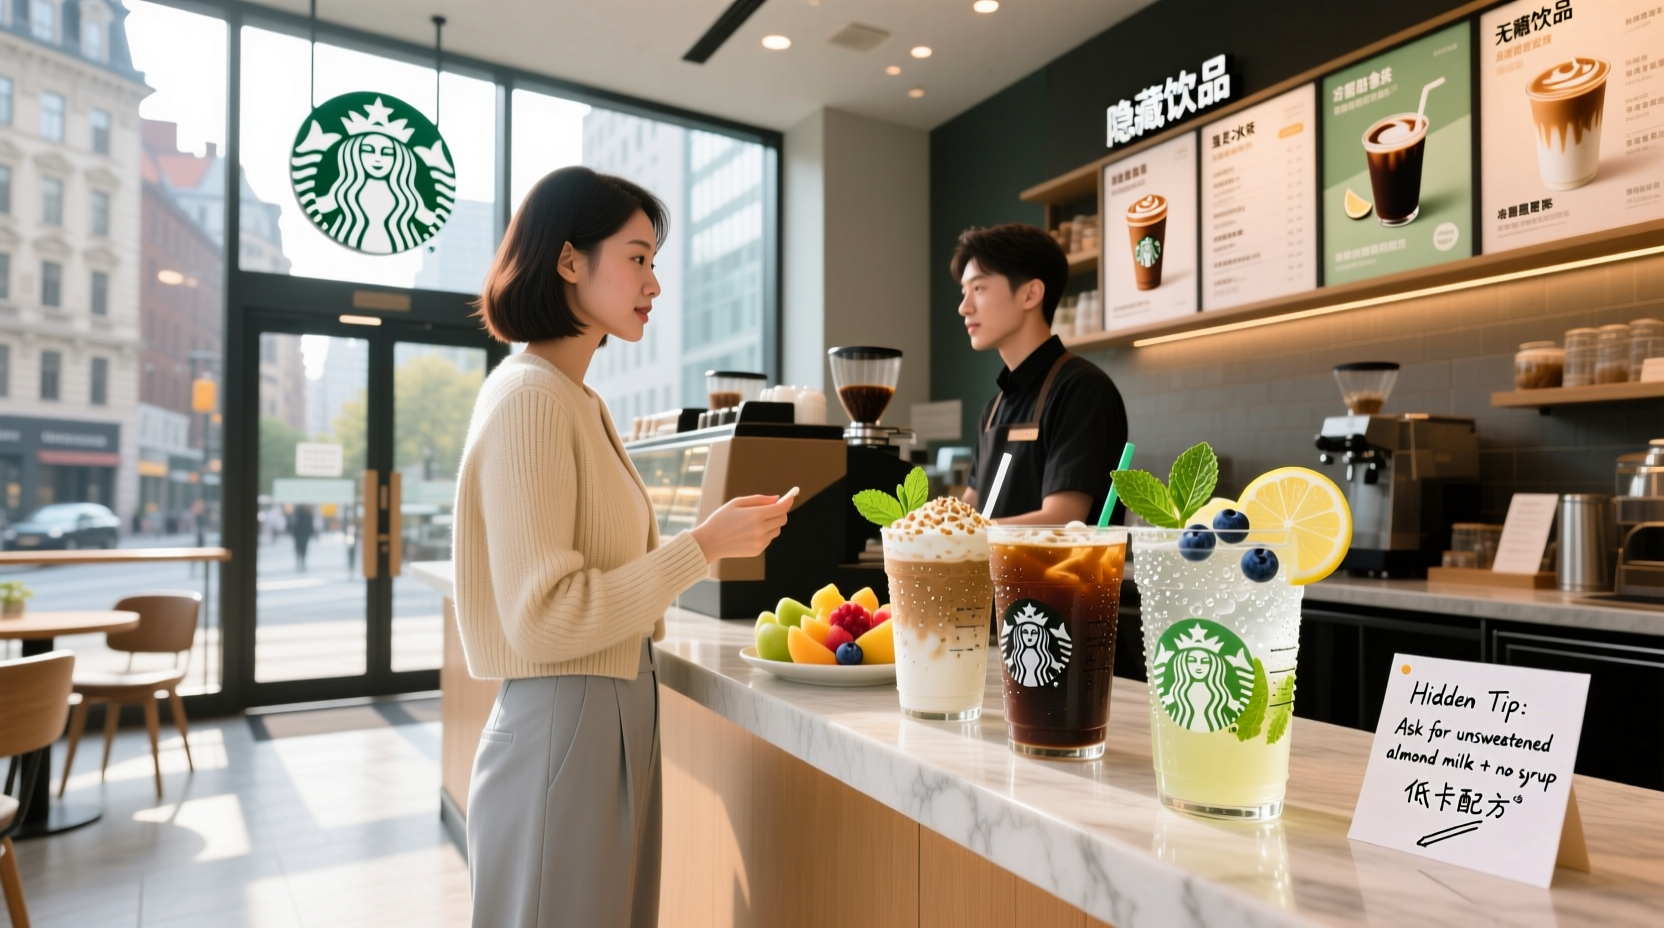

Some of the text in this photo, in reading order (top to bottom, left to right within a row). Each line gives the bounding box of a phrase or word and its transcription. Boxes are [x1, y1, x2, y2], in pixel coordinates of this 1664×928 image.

[1106, 54, 1230, 148] 隐藏饮品
[1410, 680, 1527, 723] Hidden Tip:
[1394, 717, 1554, 753] Ask for unsweetened
[1386, 743, 1439, 766] almond
[1442, 752, 1475, 771] milk
[1480, 759, 1491, 772] +
[1495, 765, 1514, 777] no
[1404, 779, 1510, 819] 低卡配方
